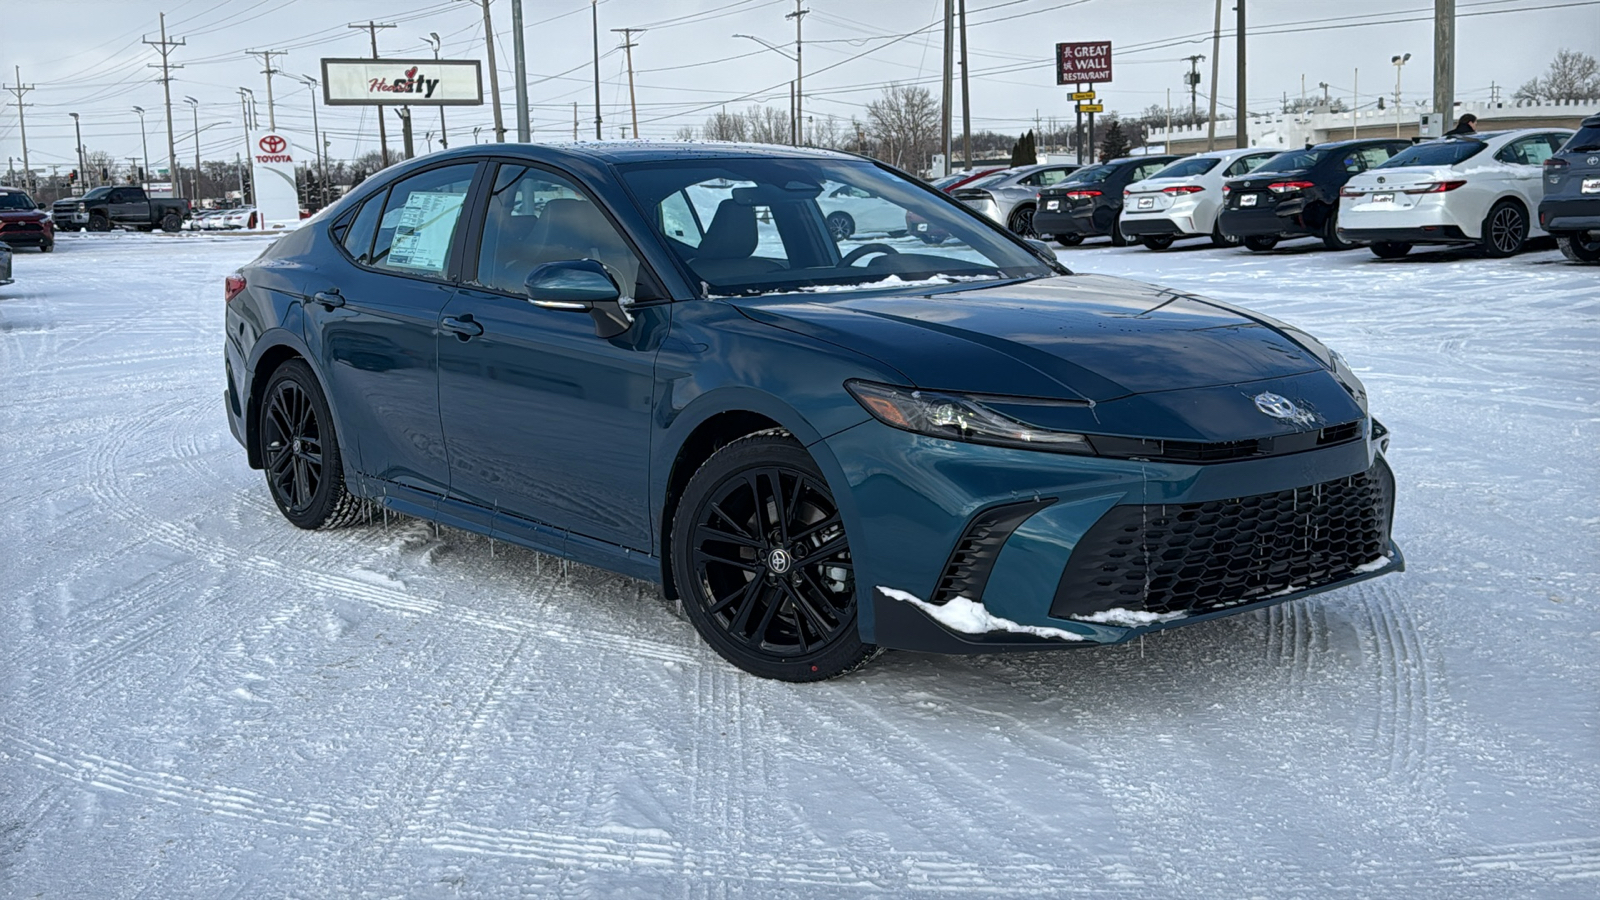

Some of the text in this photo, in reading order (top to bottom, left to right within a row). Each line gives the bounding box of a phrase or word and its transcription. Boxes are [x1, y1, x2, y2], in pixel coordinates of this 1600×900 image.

[1074, 45, 1109, 58] GREAT
[1075, 58, 1108, 70] WALL
[1063, 70, 1110, 81] RESTAURANT
[368, 77, 418, 92] Heart
[255, 155, 293, 163] TOYOTA
